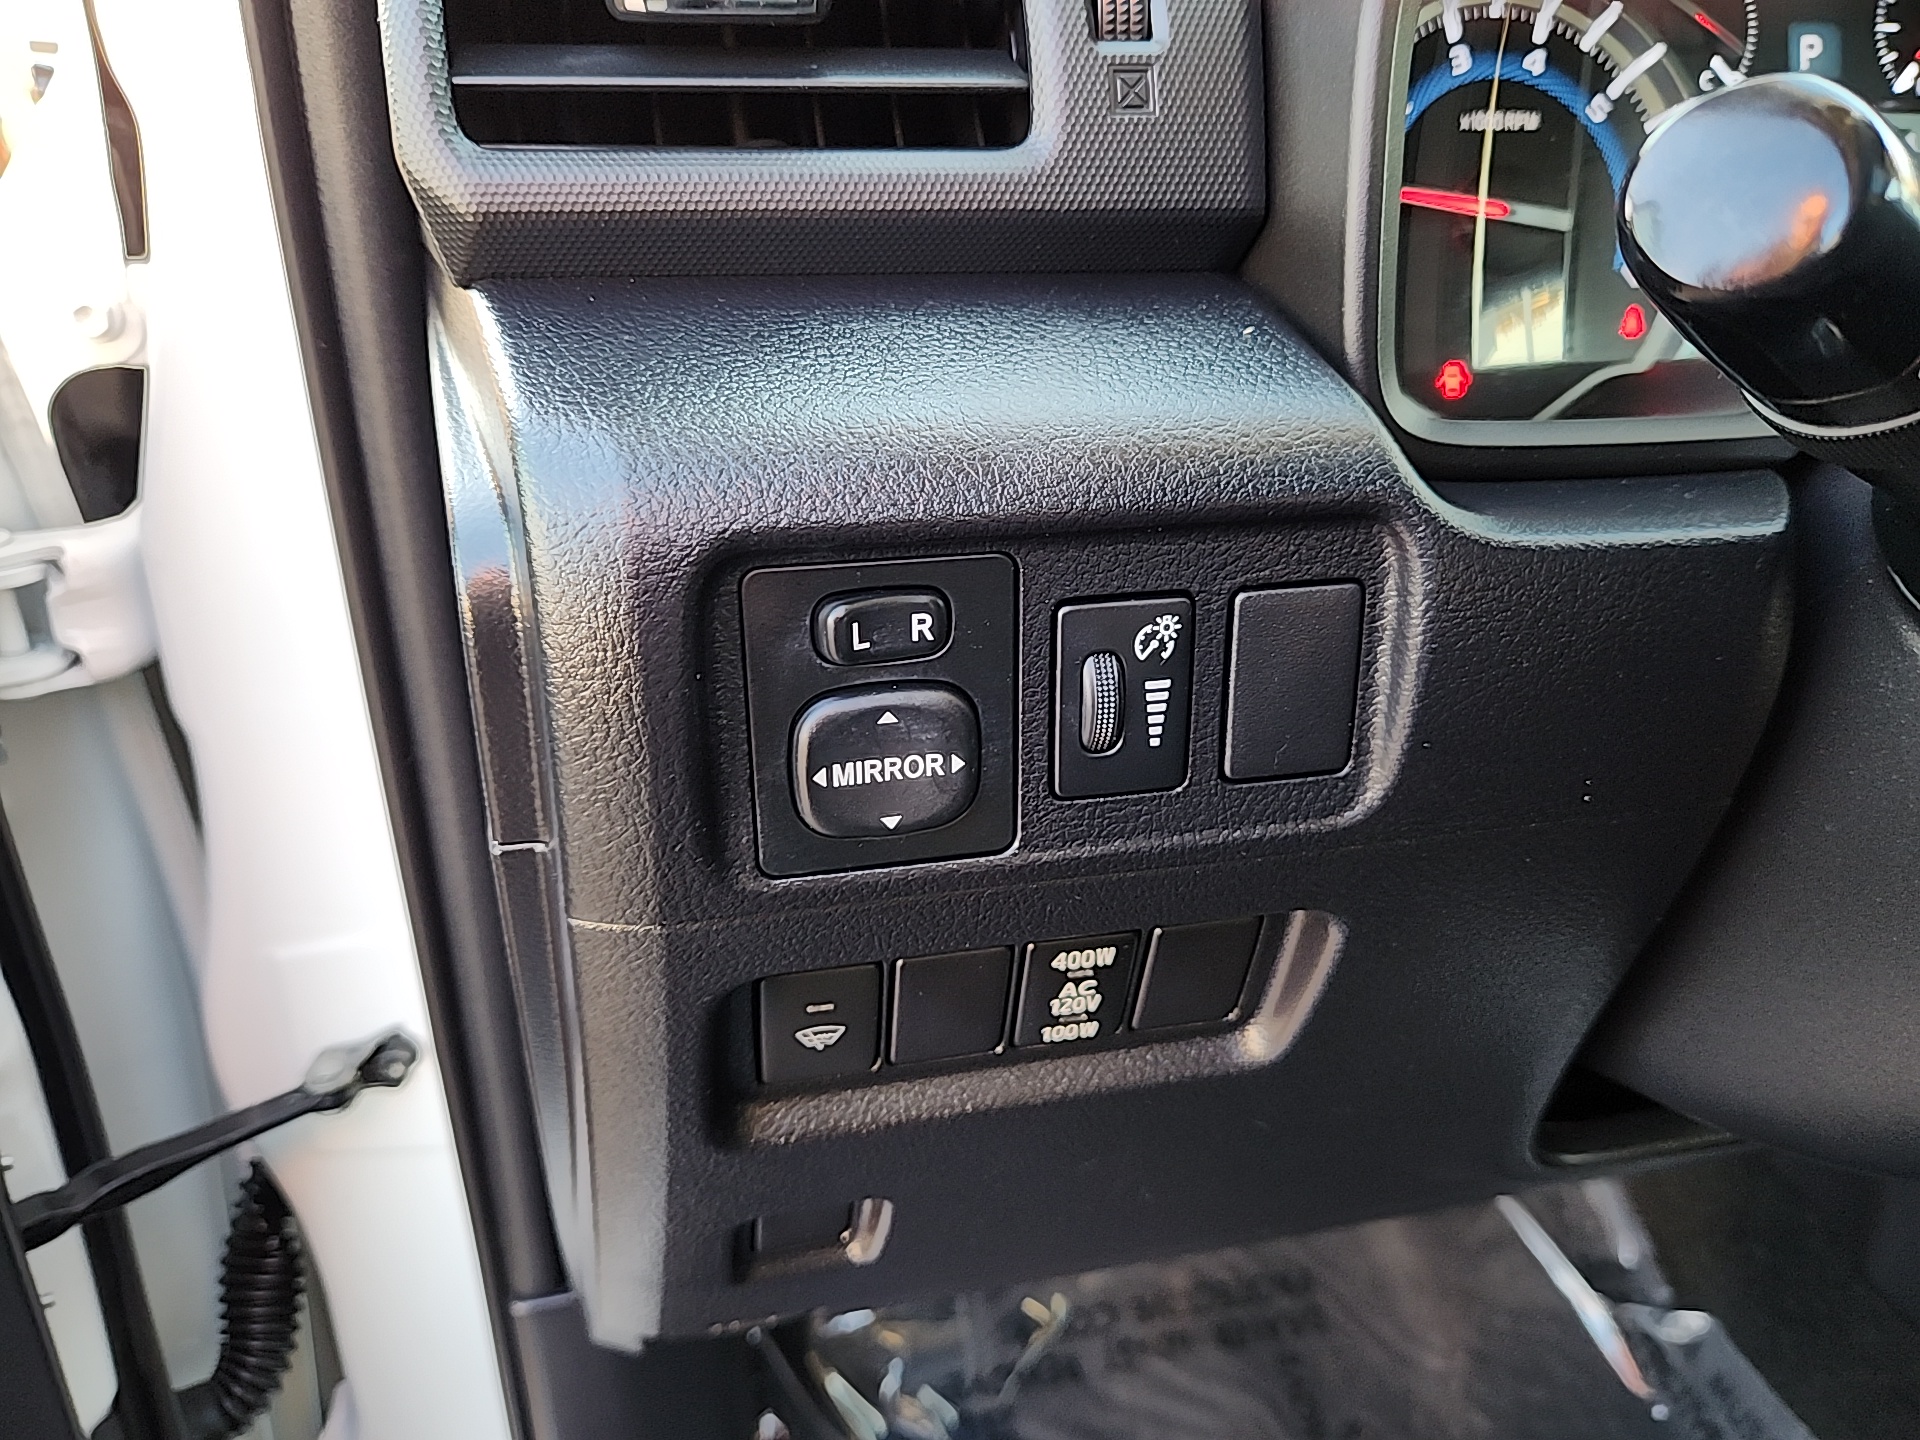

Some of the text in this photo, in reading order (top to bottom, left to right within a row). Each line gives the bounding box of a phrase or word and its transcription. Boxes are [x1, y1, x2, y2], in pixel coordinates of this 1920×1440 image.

[1449, 43, 1473, 77] 3
[1521, 47, 1548, 77] 4
[1799, 33, 1824, 71] P
[1585, 92, 1614, 124] 5
[852, 612, 935, 651] L R
[832, 753, 945, 788] MIRROR
[1050, 946, 1117, 972] 400W
[1058, 979, 1098, 999] AC
[1049, 993, 1102, 1017] 120V
[1041, 1020, 1100, 1043] 100W
